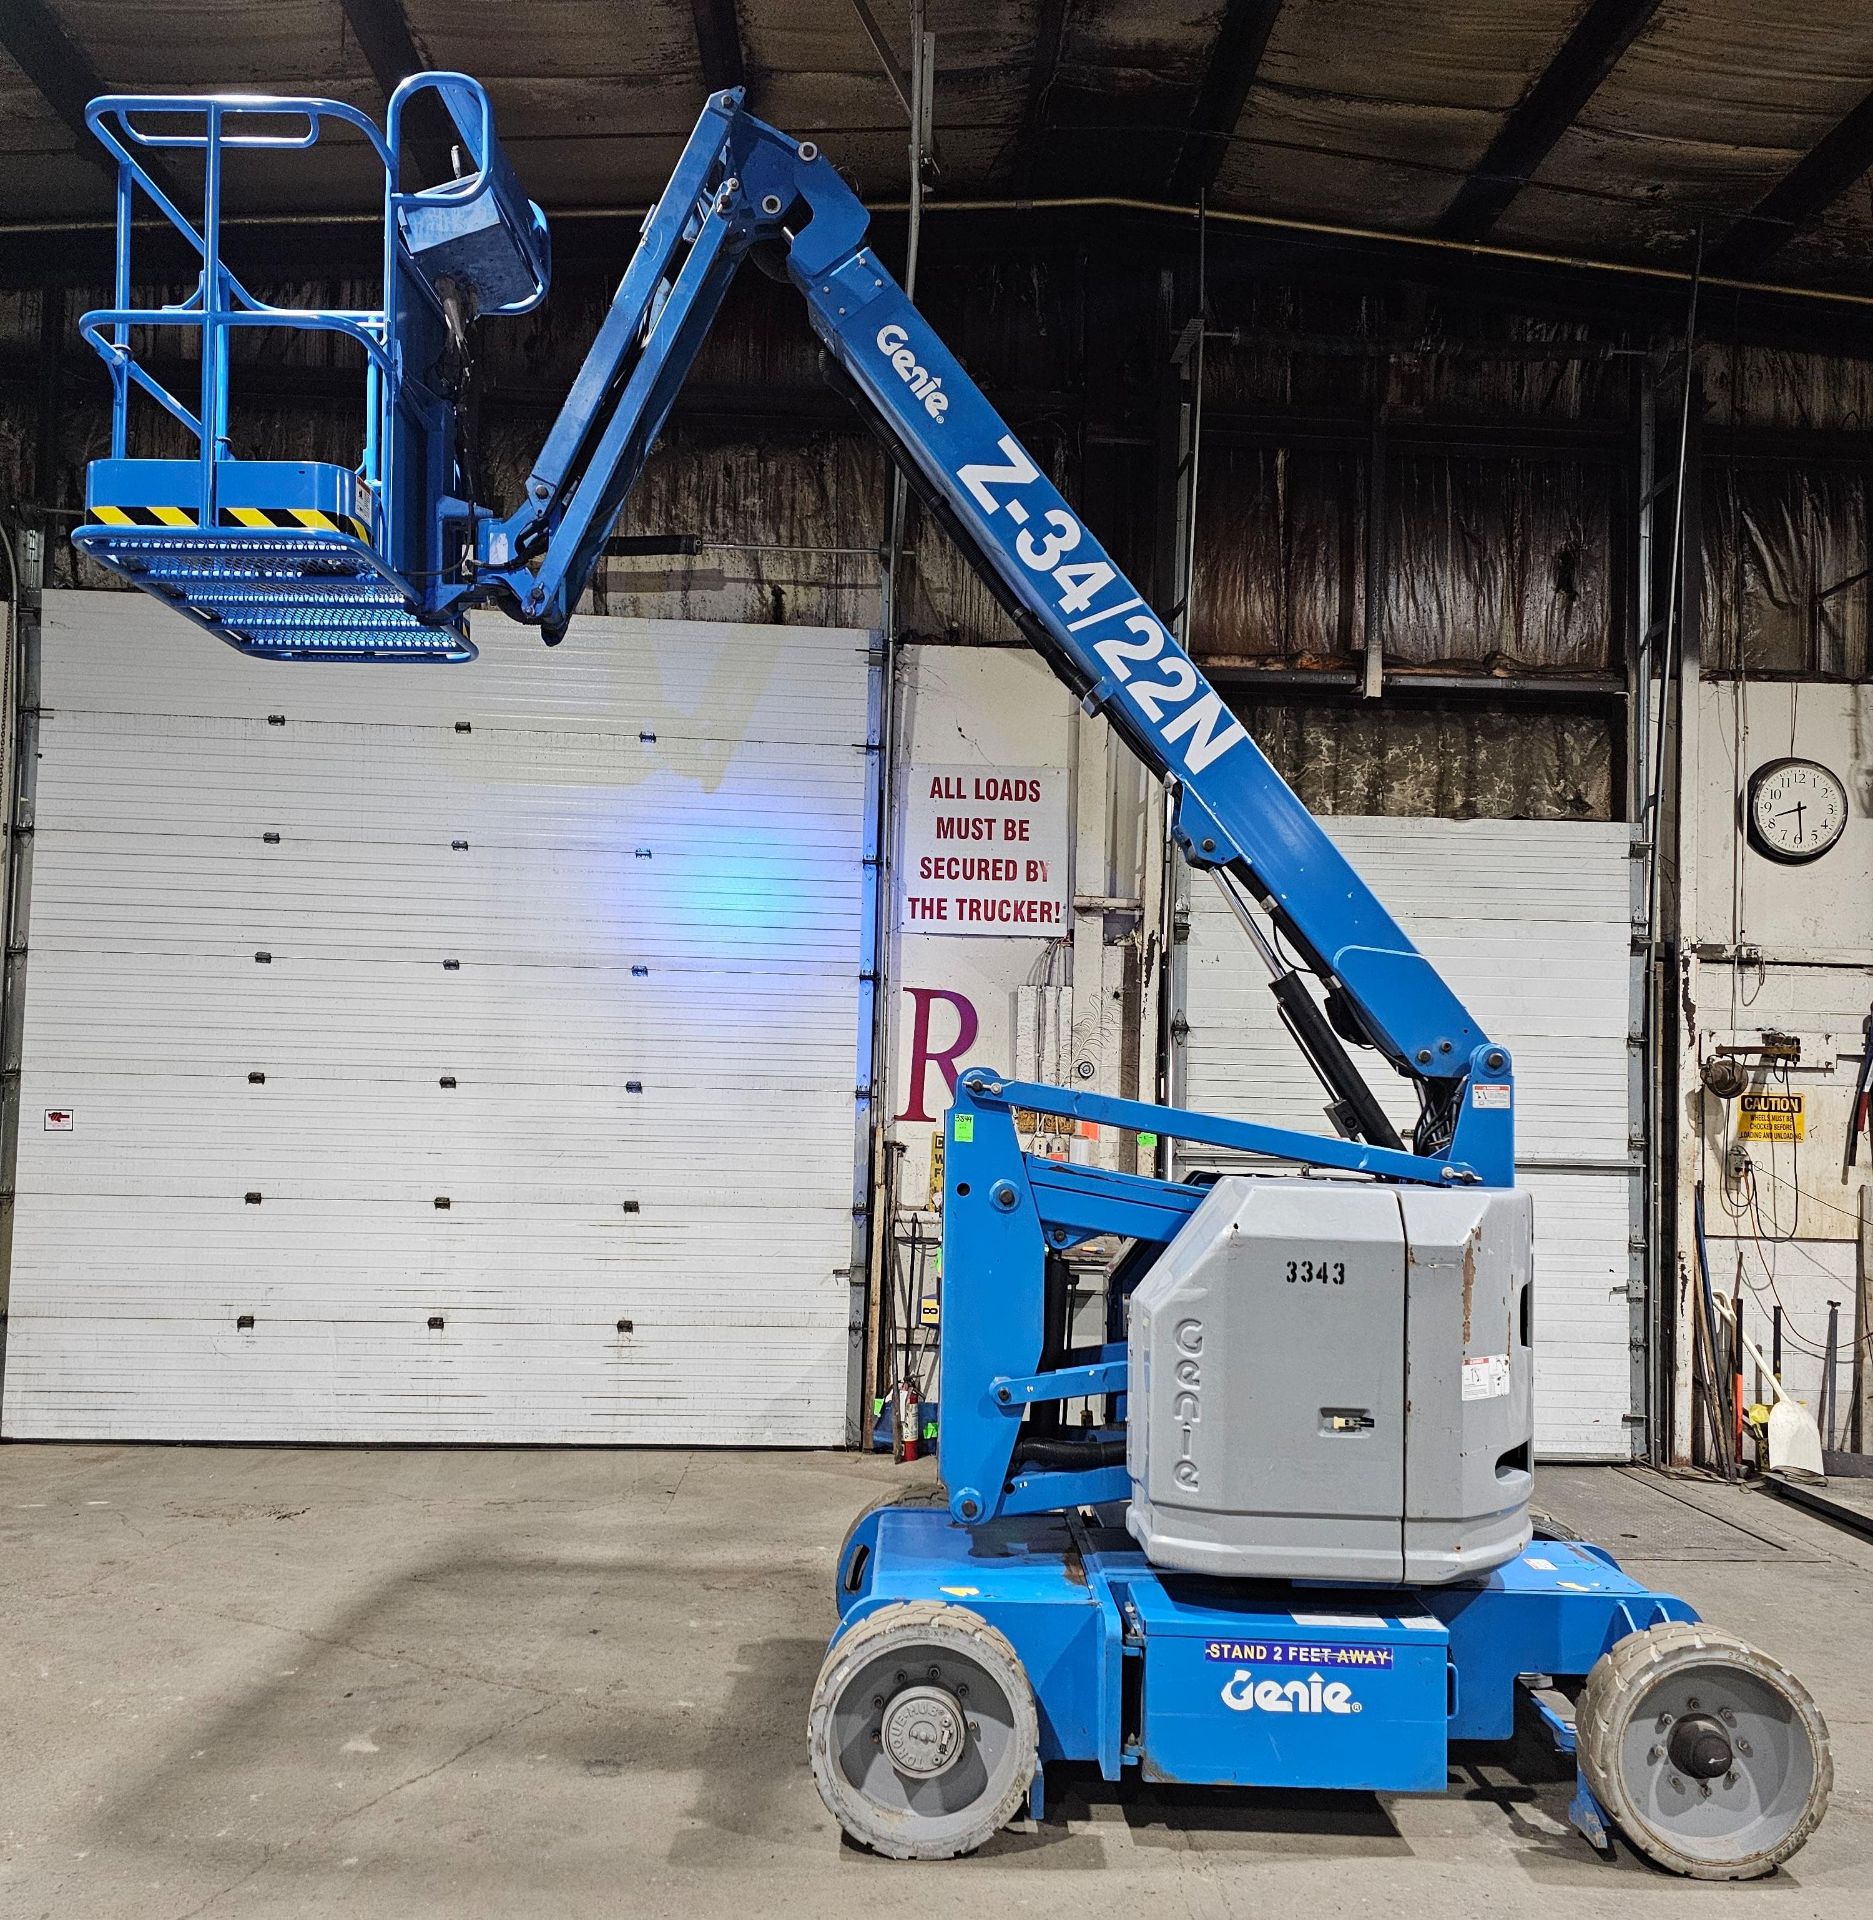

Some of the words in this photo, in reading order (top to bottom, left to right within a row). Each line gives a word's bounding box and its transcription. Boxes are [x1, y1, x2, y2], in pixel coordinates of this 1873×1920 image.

[956, 434, 1247, 776] Z-34/22N
[1780, 777, 1790, 788] 11
[1794, 773, 1806, 784] 12
[929, 776, 967, 800] ALL
[974, 778, 1041, 803] LOADS
[1769, 788, 1782, 800] 10
[1820, 787, 1829, 799] 2
[1764, 801, 1772, 813] 9
[1827, 803, 1834, 815] 3
[936, 816, 997, 841] MUST
[1003, 818, 1030, 842] BE
[1767, 818, 1776, 829] 8
[1820, 819, 1829, 829] 4
[1780, 829, 1788, 841] 7
[1793, 833, 1802, 844] 6
[1810, 829, 1818, 841] 5
[919, 856, 1018, 882] SECURED
[1026, 859, 1050, 882] BY
[907, 897, 948, 921] THE
[955, 898, 1061, 924] TRUCKER!
[894, 986, 978, 1122] R
[1744, 1097, 1799, 1111] CAUTION
[1750, 1114, 1770, 1122] WHEELS
[1771, 1114, 1785, 1122] MUST
[1773, 1123, 1793, 1131] BEFORE
[1740, 1131, 1763, 1139] LOADING
[1773, 1132, 1802, 1140] UNLOADNG
[1286, 1261, 1346, 1285] 3343
[1209, 1643, 1267, 1660] STAND
[1273, 1646, 1283, 1661] 2
[1288, 1646, 1331, 1663] FEET
[1337, 1648, 1388, 1665] AWAY
